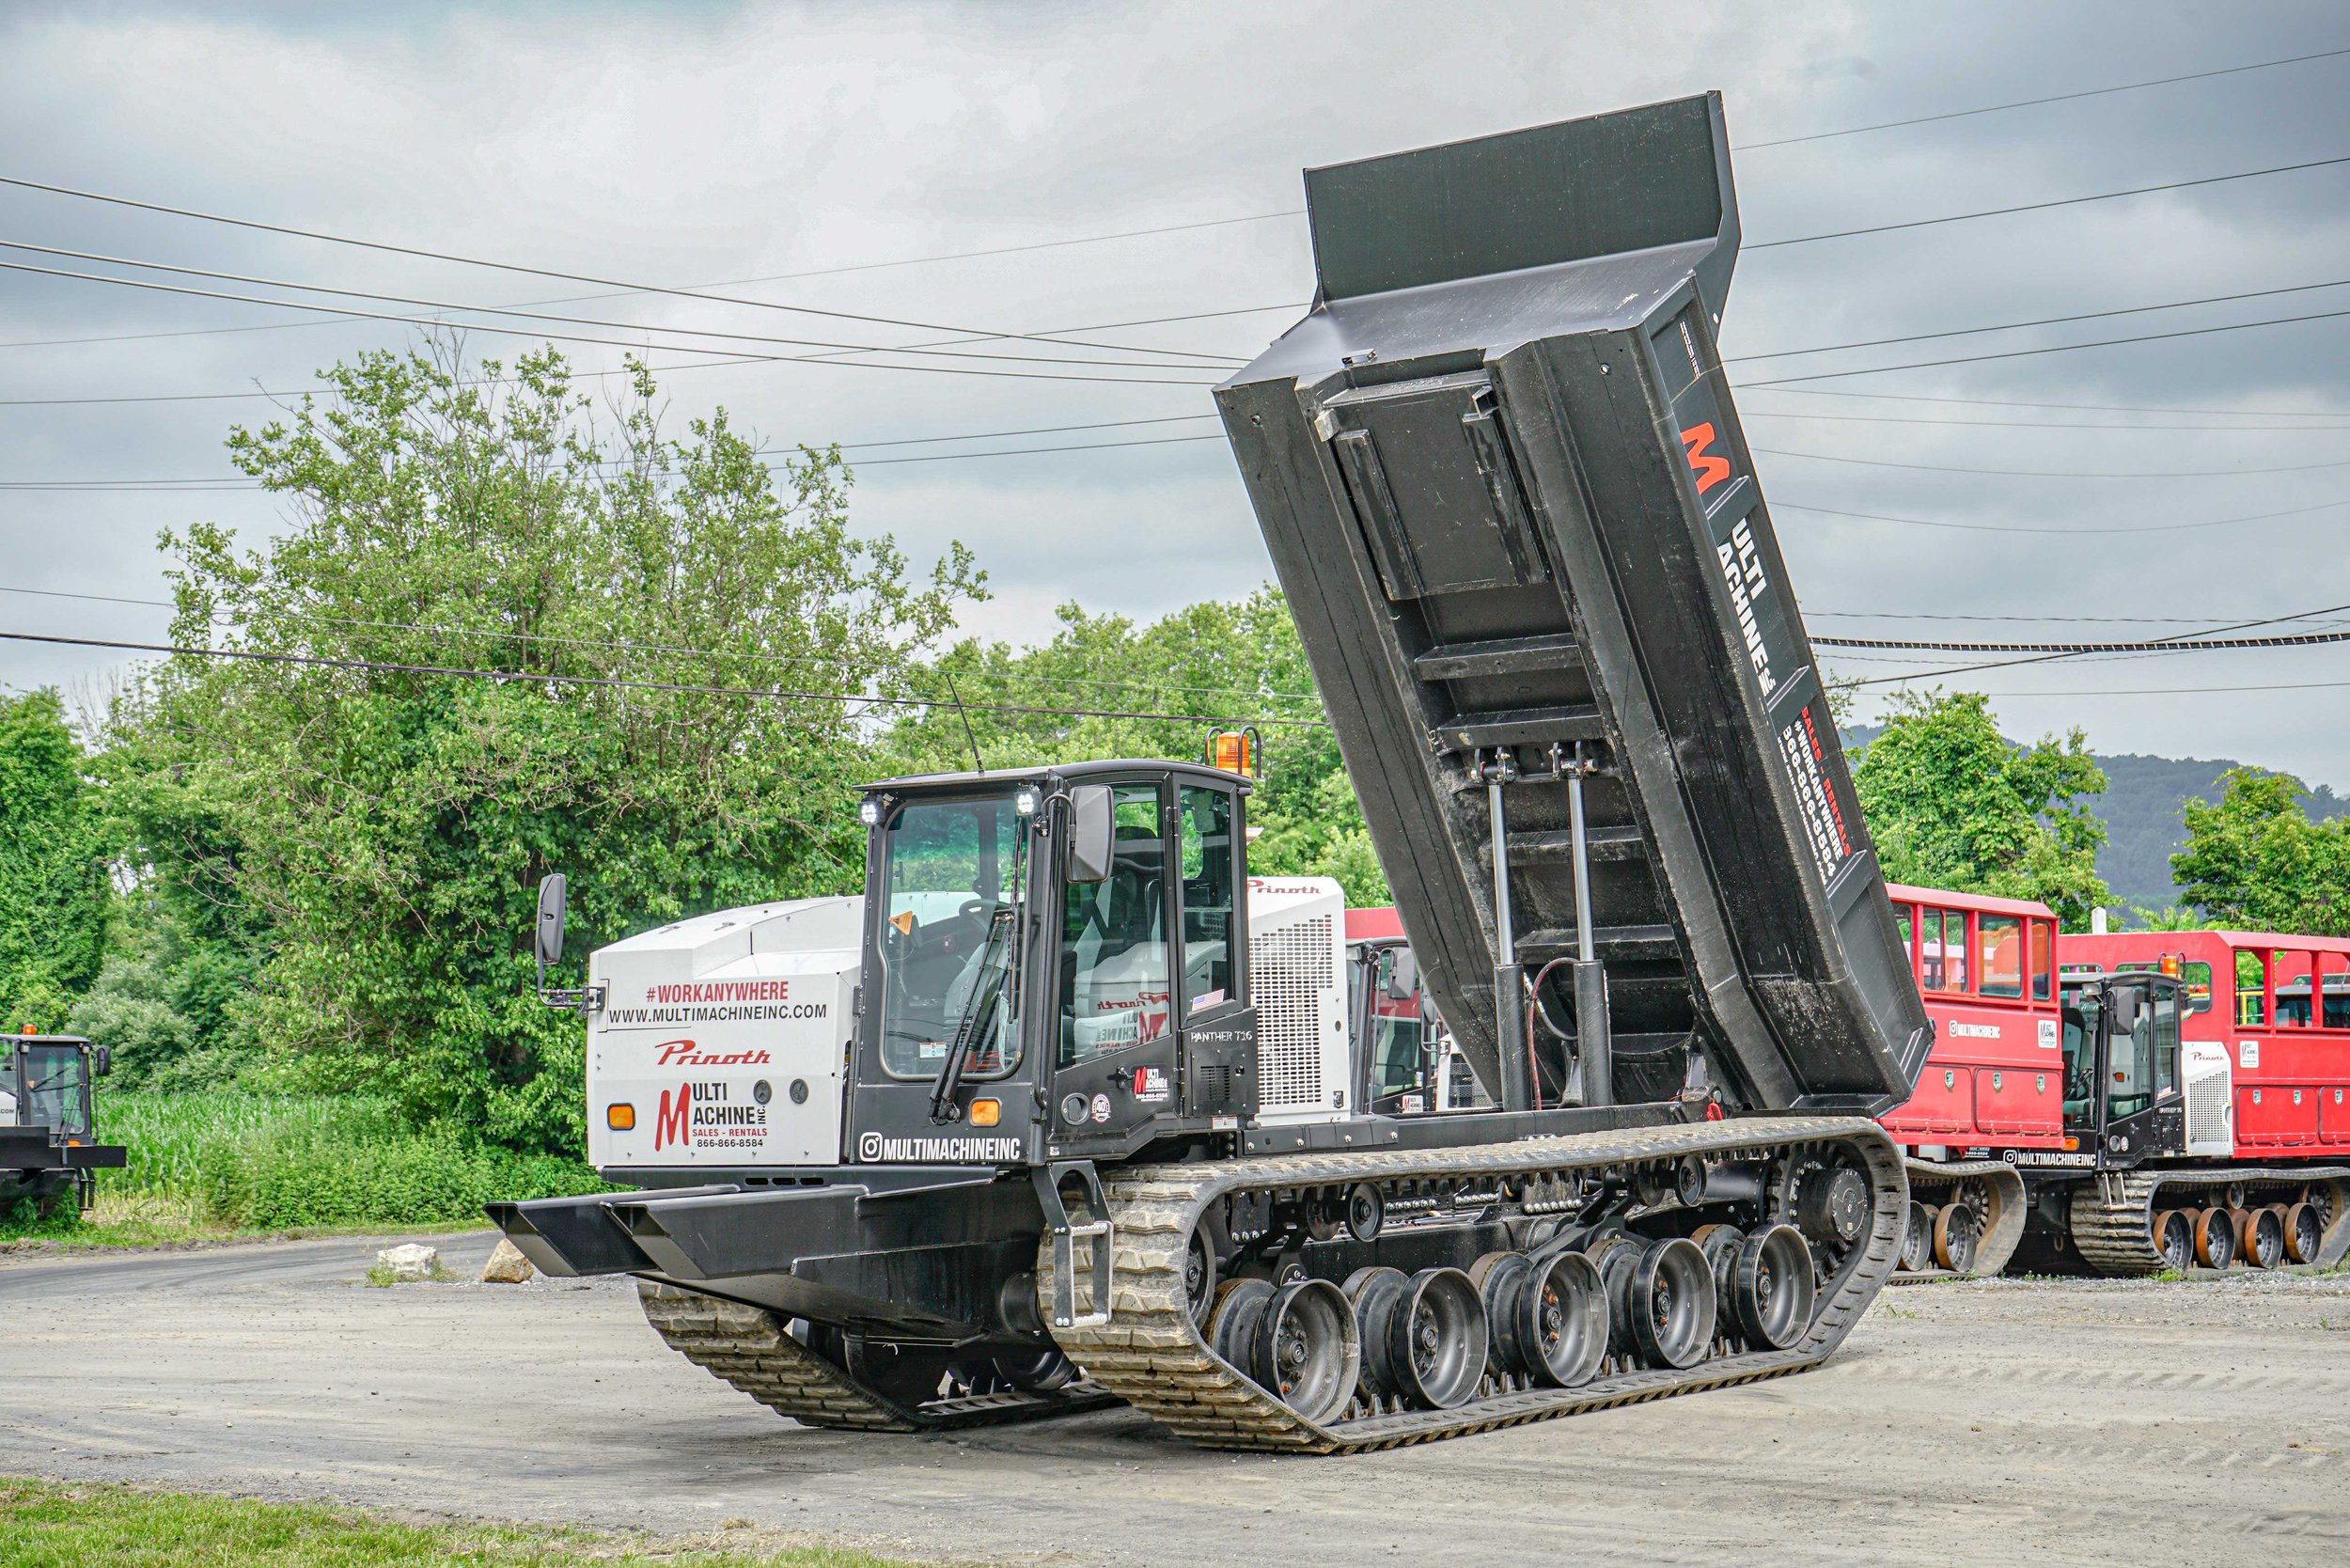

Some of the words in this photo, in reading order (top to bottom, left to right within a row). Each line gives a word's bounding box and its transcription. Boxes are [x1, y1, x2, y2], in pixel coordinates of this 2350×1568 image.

[1794, 719, 1844, 862] #WORKANYWHERE
[1801, 706, 1822, 762] SALES
[1823, 777, 1851, 857] RENTALS
[647, 980, 789, 1003] #WORKANYWHERE
[609, 1004, 827, 1024] WWW.MULTIMACHINEINC.COM
[1190, 1031, 1233, 1043] PANTHER
[655, 1040, 771, 1065] Prinoth
[757, 1105, 766, 1124] INC.
[728, 1128, 767, 1137] RENTALS
[697, 1138, 763, 1148] 866-866-8584
[884, 1137, 1021, 1160] MULTIMACHINEINC
[2017, 1152, 2096, 1167] MULTIMACHINEINC
